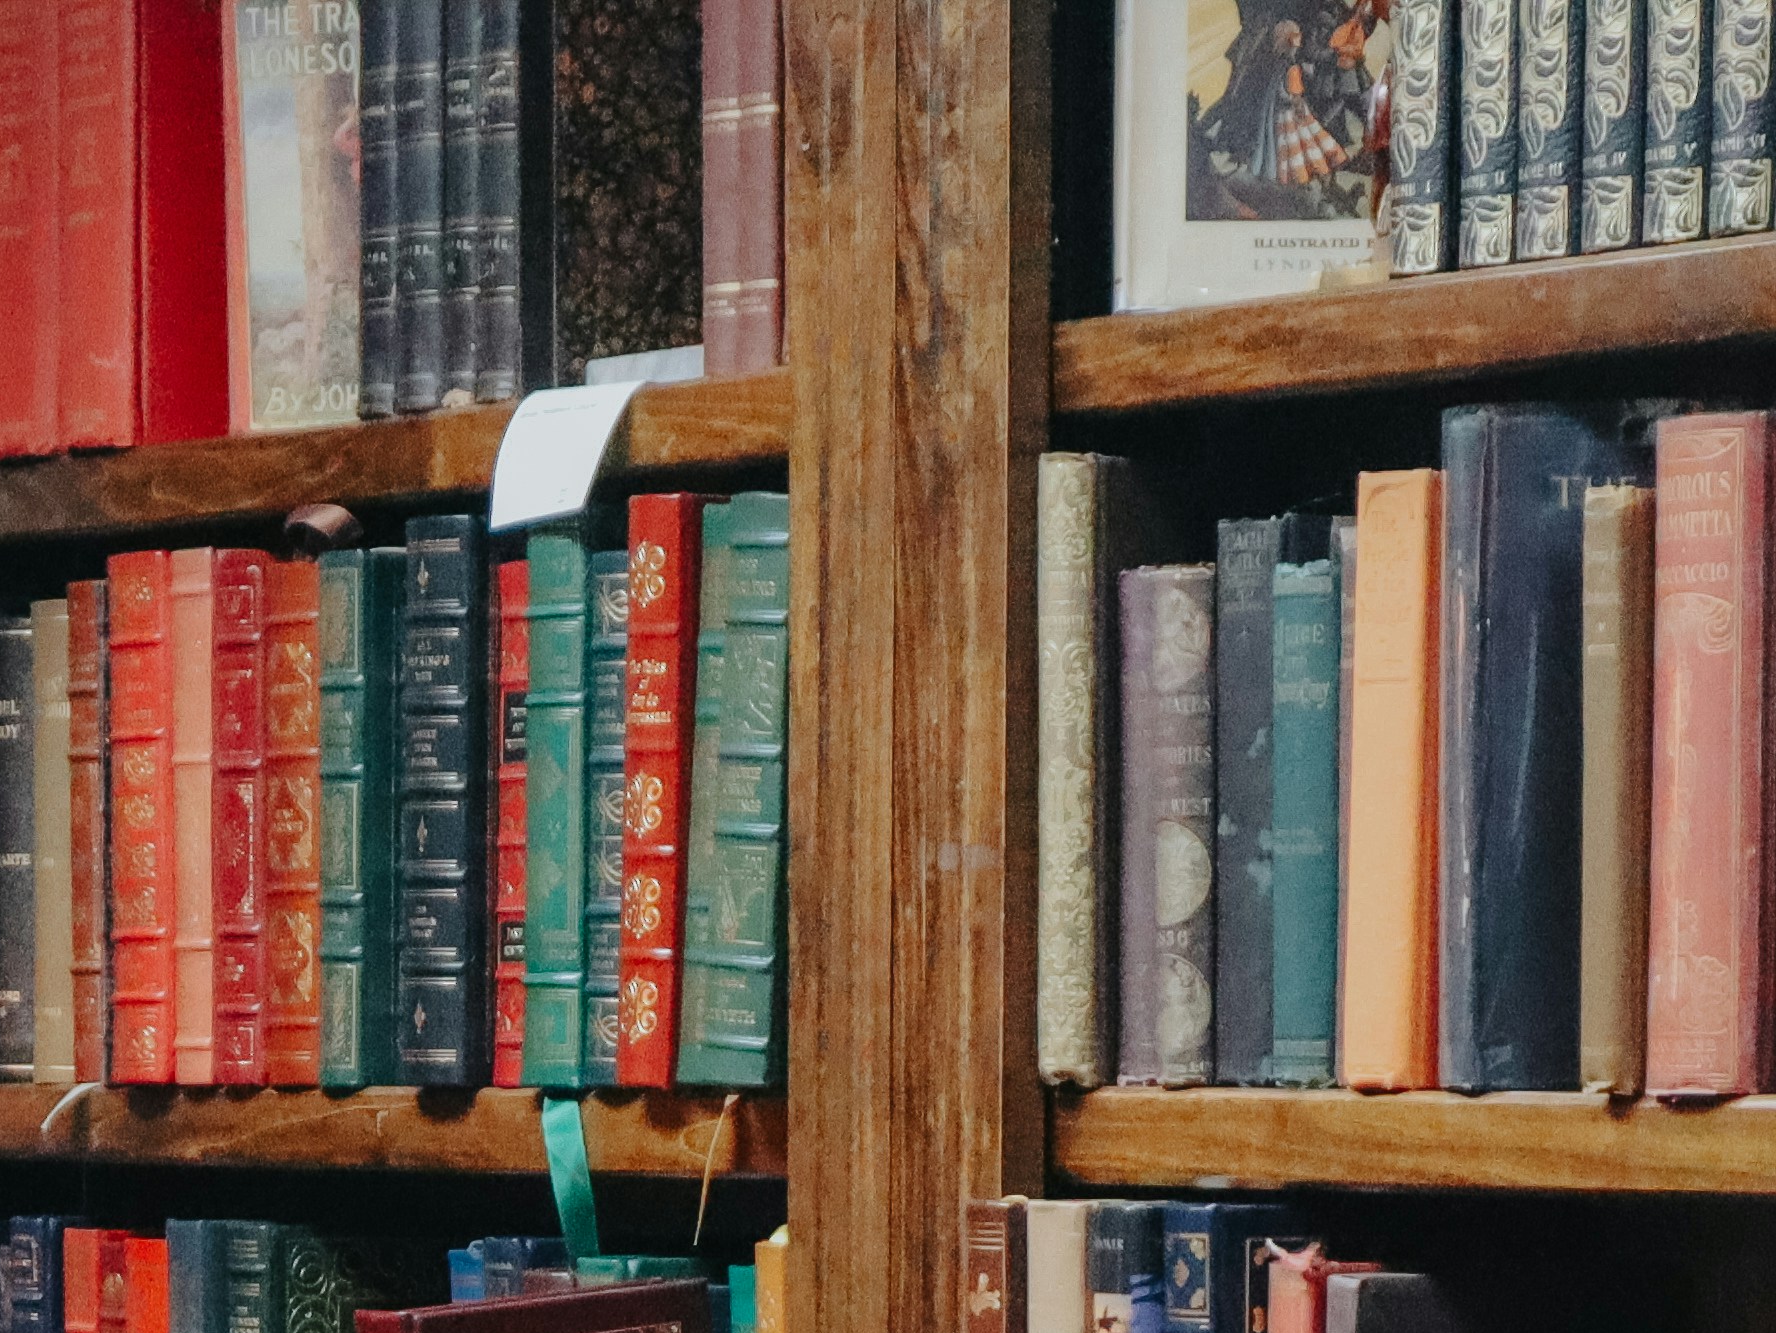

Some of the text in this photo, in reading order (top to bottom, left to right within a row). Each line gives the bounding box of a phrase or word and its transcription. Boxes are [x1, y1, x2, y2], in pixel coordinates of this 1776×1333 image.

[246, 2, 360, 36] THE TRA
[249, 41, 356, 76] LONESO
[1253, 237, 1362, 250] ILLUSTRATED
[1253, 256, 1312, 273] LYND
[264, 383, 360, 415] By JOH
